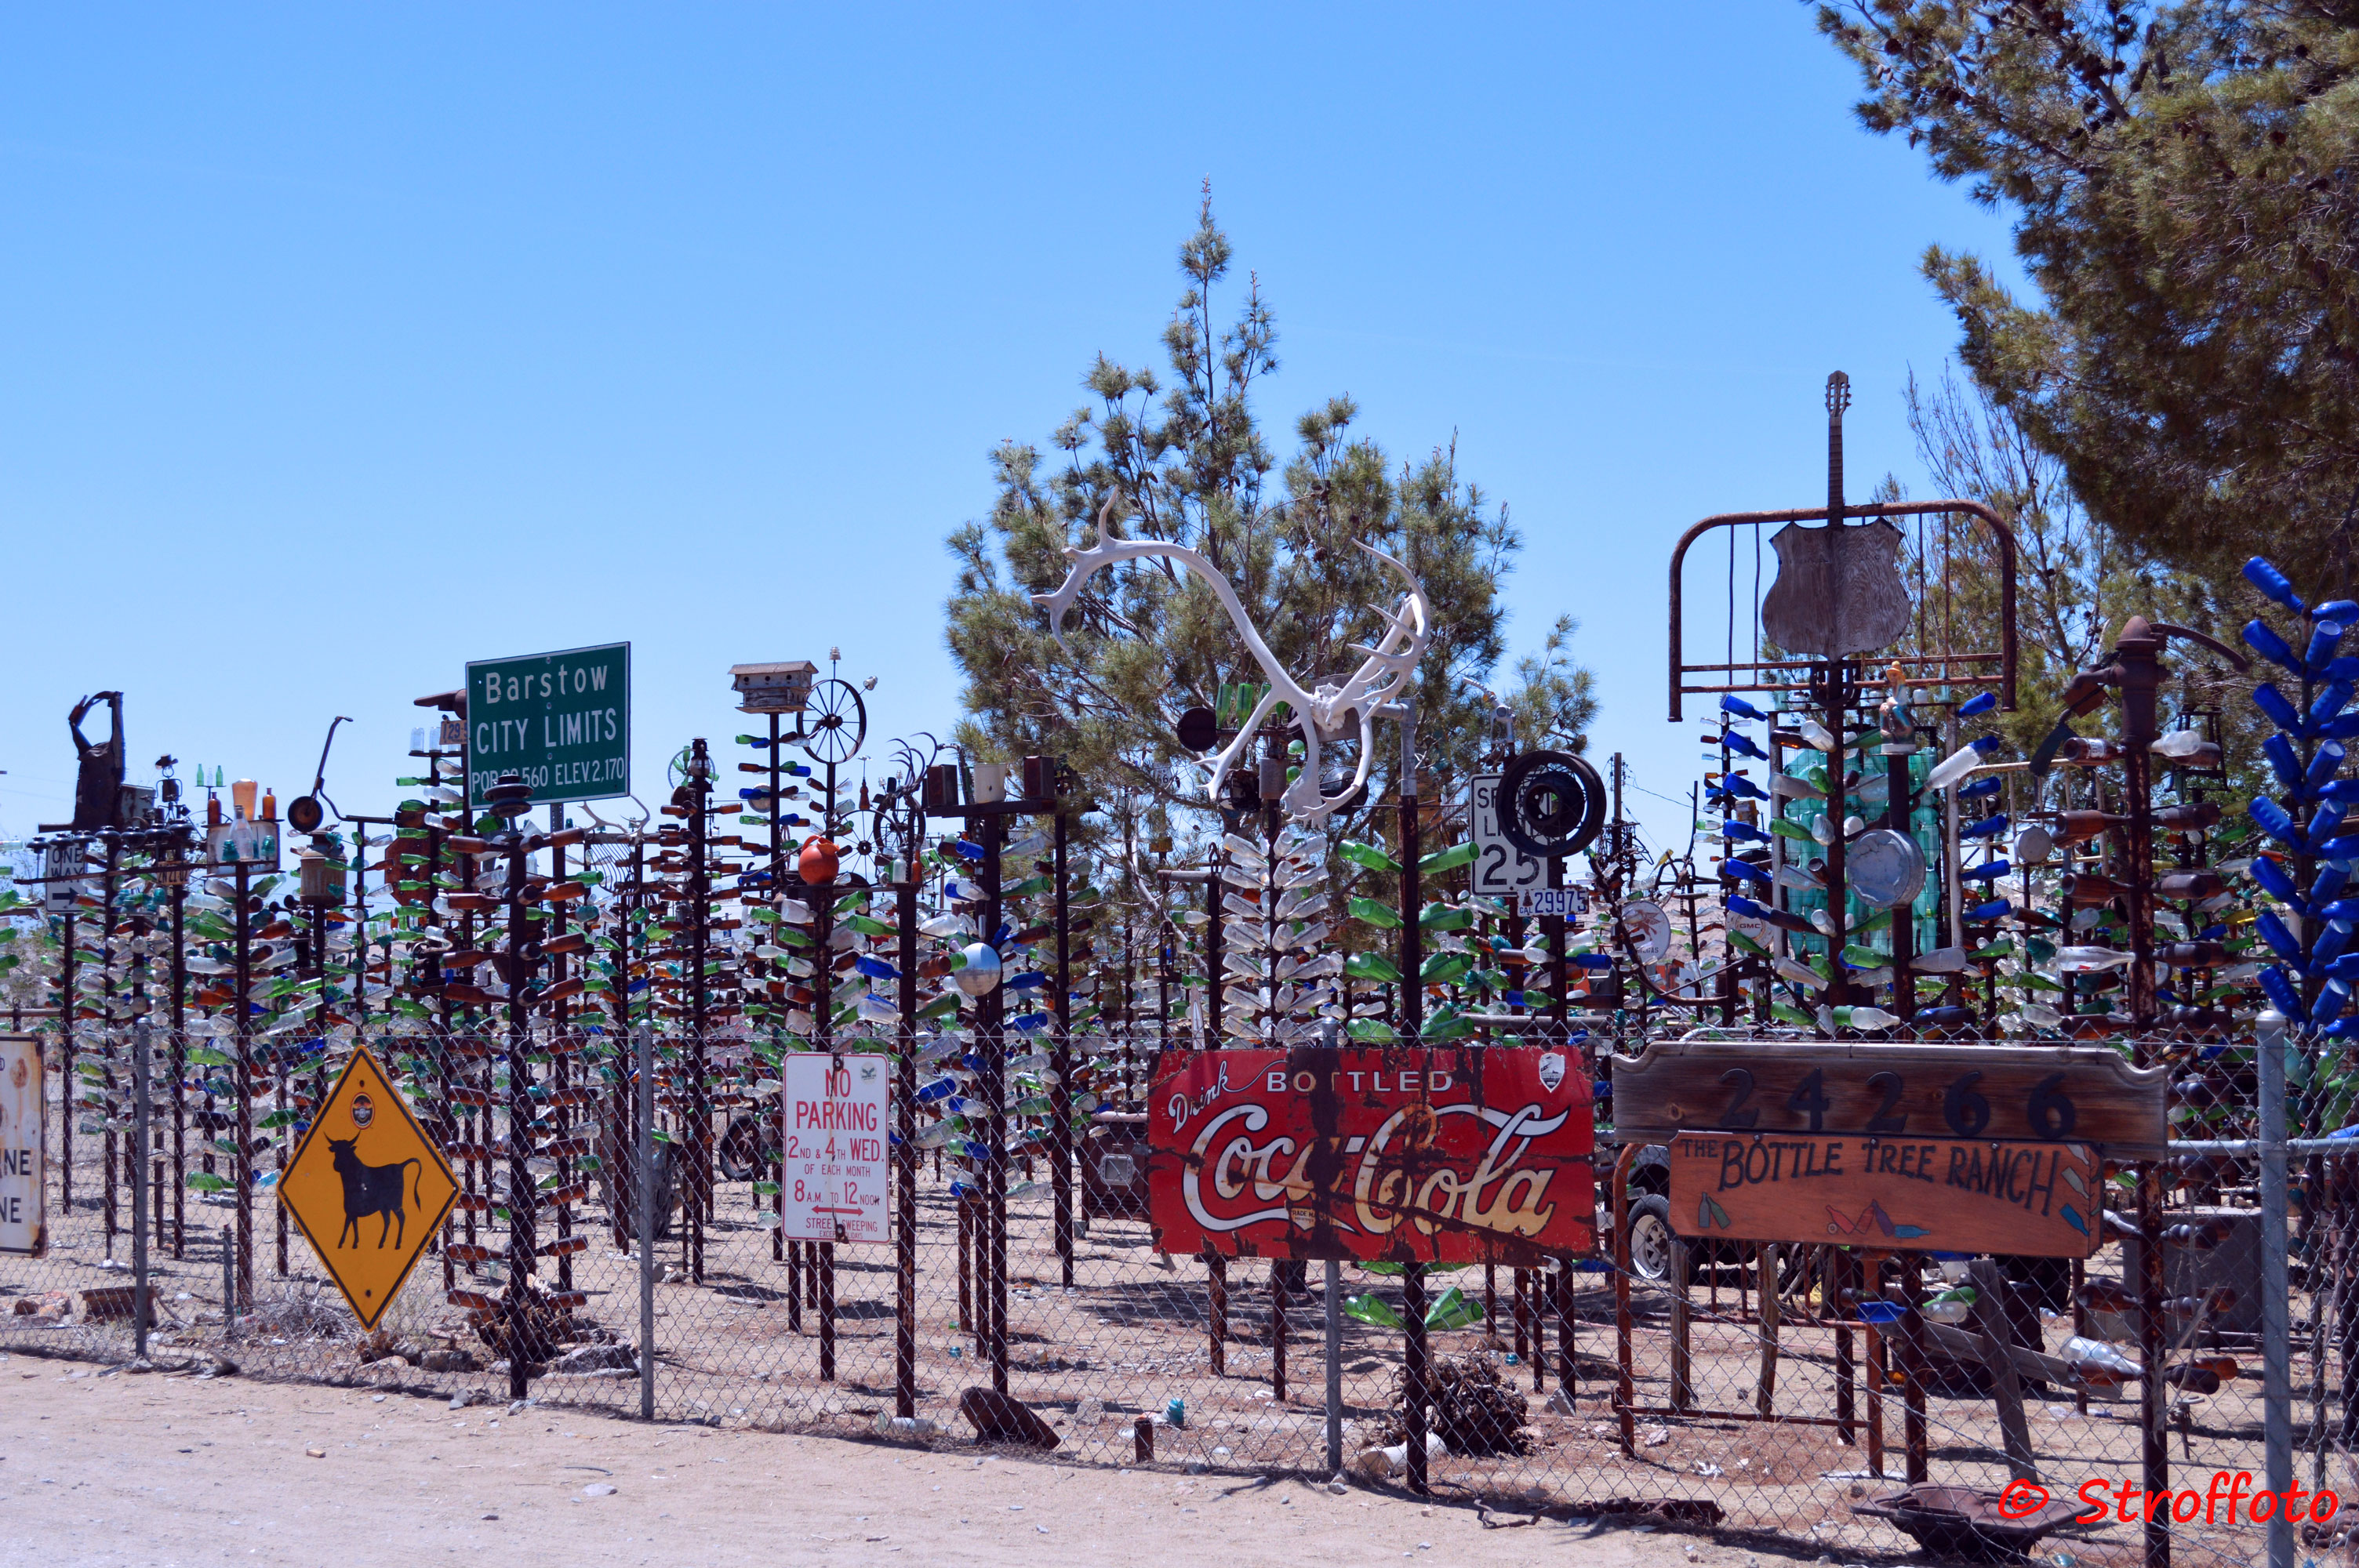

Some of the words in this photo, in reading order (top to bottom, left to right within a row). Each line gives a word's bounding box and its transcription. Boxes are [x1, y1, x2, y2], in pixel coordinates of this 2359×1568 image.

[485, 664, 608, 704] Barstow
[476, 718, 529, 754] CITY
[544, 707, 617, 748] LIMITS
[591, 757, 625, 783] 2,170
[52, 848, 82, 863] ONE
[1482, 844, 1539, 886] 25
[1519, 906, 1533, 914] CAL
[1534, 891, 1587, 914] 29975
[825, 1068, 852, 1098] NO
[1168, 1060, 1234, 1134] Drink
[796, 1101, 878, 1132] PARKING
[788, 1135, 811, 1159] 2ND
[816, 1149, 821, 1159] &
[825, 1137, 846, 1160] 4TH
[850, 1138, 885, 1163] WED.
[804, 1163, 815, 1175] OF
[821, 1164, 841, 1175] EACH
[846, 1165, 871, 1178] MONTH
[1680, 1138, 1719, 1160] THE
[1717, 1139, 1845, 1192] BOTTLE
[1862, 1140, 1936, 1181] TREE
[1945, 1145, 2061, 1217] RANCH
[794, 1179, 805, 1202] 8
[831, 1192, 839, 1203] TO
[844, 1181, 858, 1205] 12
[841, 1219, 878, 1232] SWEEPING
